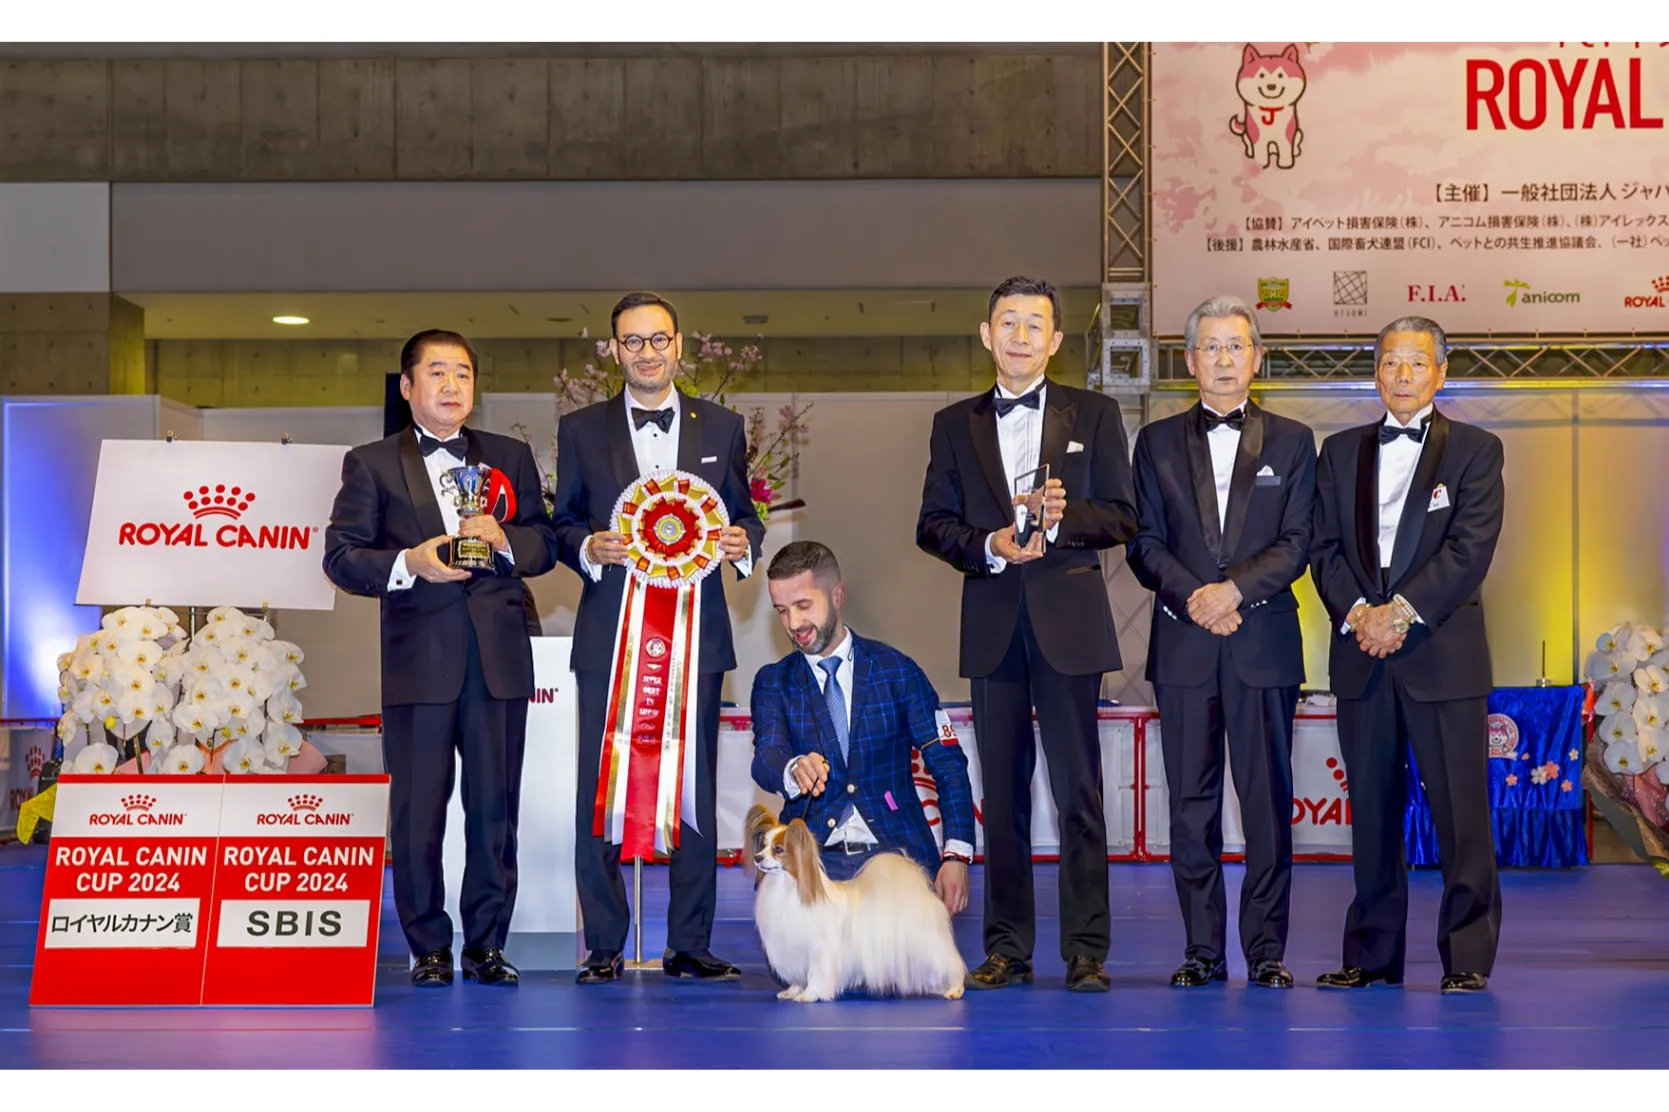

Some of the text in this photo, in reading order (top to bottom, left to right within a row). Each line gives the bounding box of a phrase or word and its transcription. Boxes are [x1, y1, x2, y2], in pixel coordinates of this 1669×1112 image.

[1465, 56, 1664, 131] ROYAL
[1522, 291, 1581, 304] anicom
[1624, 296, 1666, 308] ROYAL
[118, 522, 311, 550] ROYAL CANIN
[89, 813, 184, 826] ROYAL CANIN
[256, 813, 350, 826] ROYAL CANIN
[55, 846, 207, 866] ROYAL CANIN
[223, 846, 374, 866] ROYAL CANIN
[76, 872, 181, 892] CUP 2024
[244, 872, 348, 892] CUP 2024
[51, 912, 193, 933] ロイヤルカナン賞
[246, 910, 342, 936] SBIS
